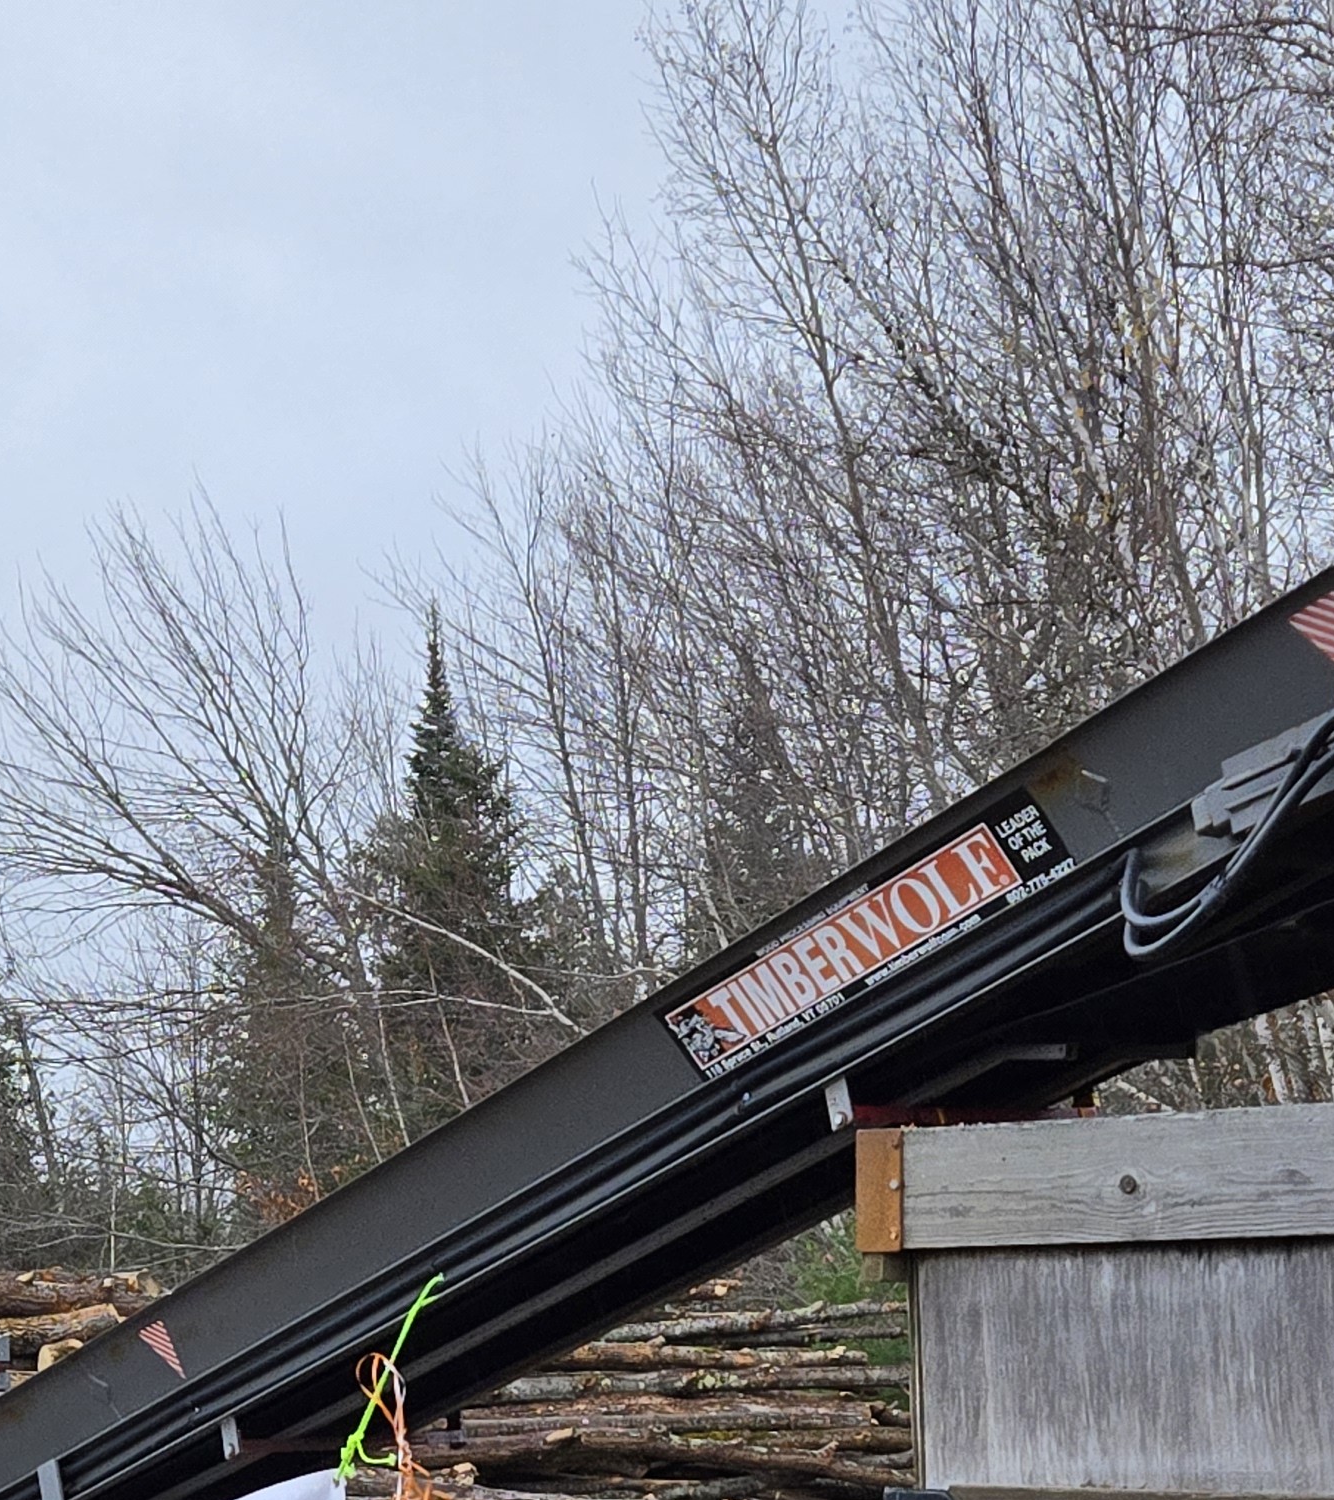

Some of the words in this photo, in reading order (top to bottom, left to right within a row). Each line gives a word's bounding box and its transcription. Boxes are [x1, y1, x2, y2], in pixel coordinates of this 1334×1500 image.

[995, 805, 1039, 837] LEADER
[1006, 831, 1026, 851] OF
[1021, 819, 1046, 842] THE
[1020, 837, 1052, 863] PACK
[707, 836, 1003, 1040] TIMBERWOLF
[800, 1007, 817, 1022] VT
